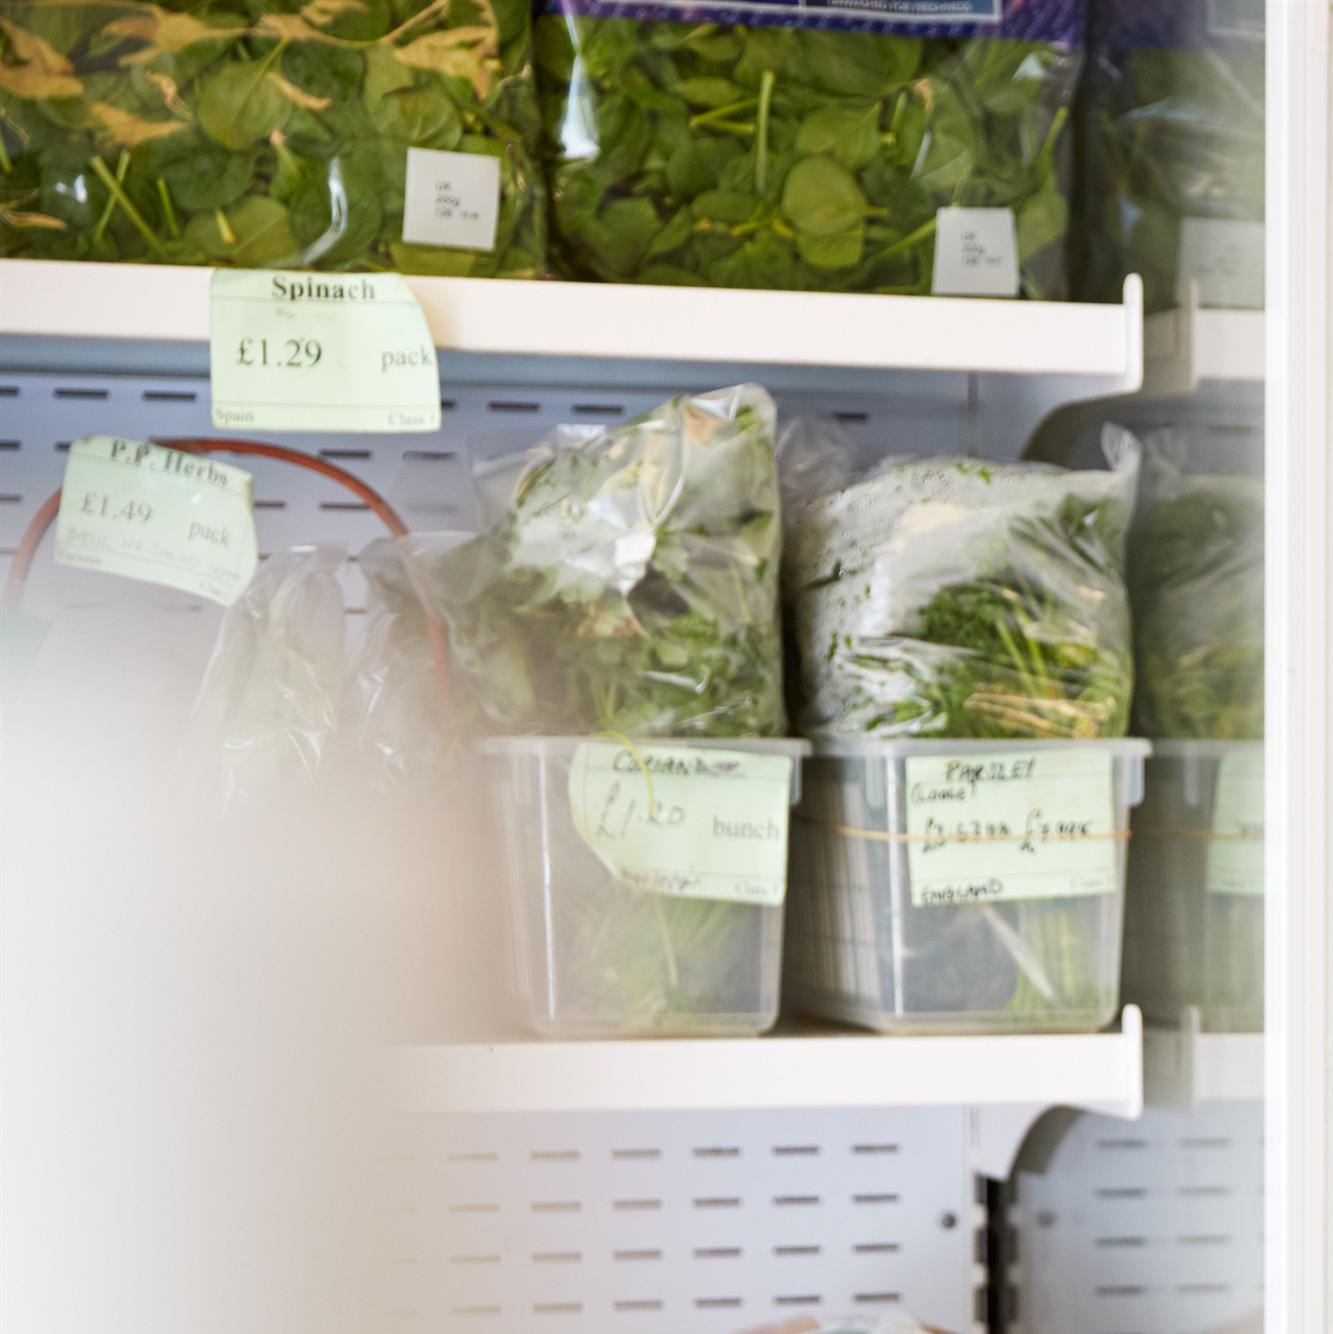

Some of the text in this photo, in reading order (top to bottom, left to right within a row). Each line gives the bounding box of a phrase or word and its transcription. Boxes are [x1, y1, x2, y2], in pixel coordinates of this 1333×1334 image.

[271, 274, 375, 301] Spinach
[236, 337, 433, 371] £1.29 pack
[164, 450, 229, 487] Herbs
[80, 491, 230, 547] £1.49 pack
[712, 814, 780, 840] bunch
